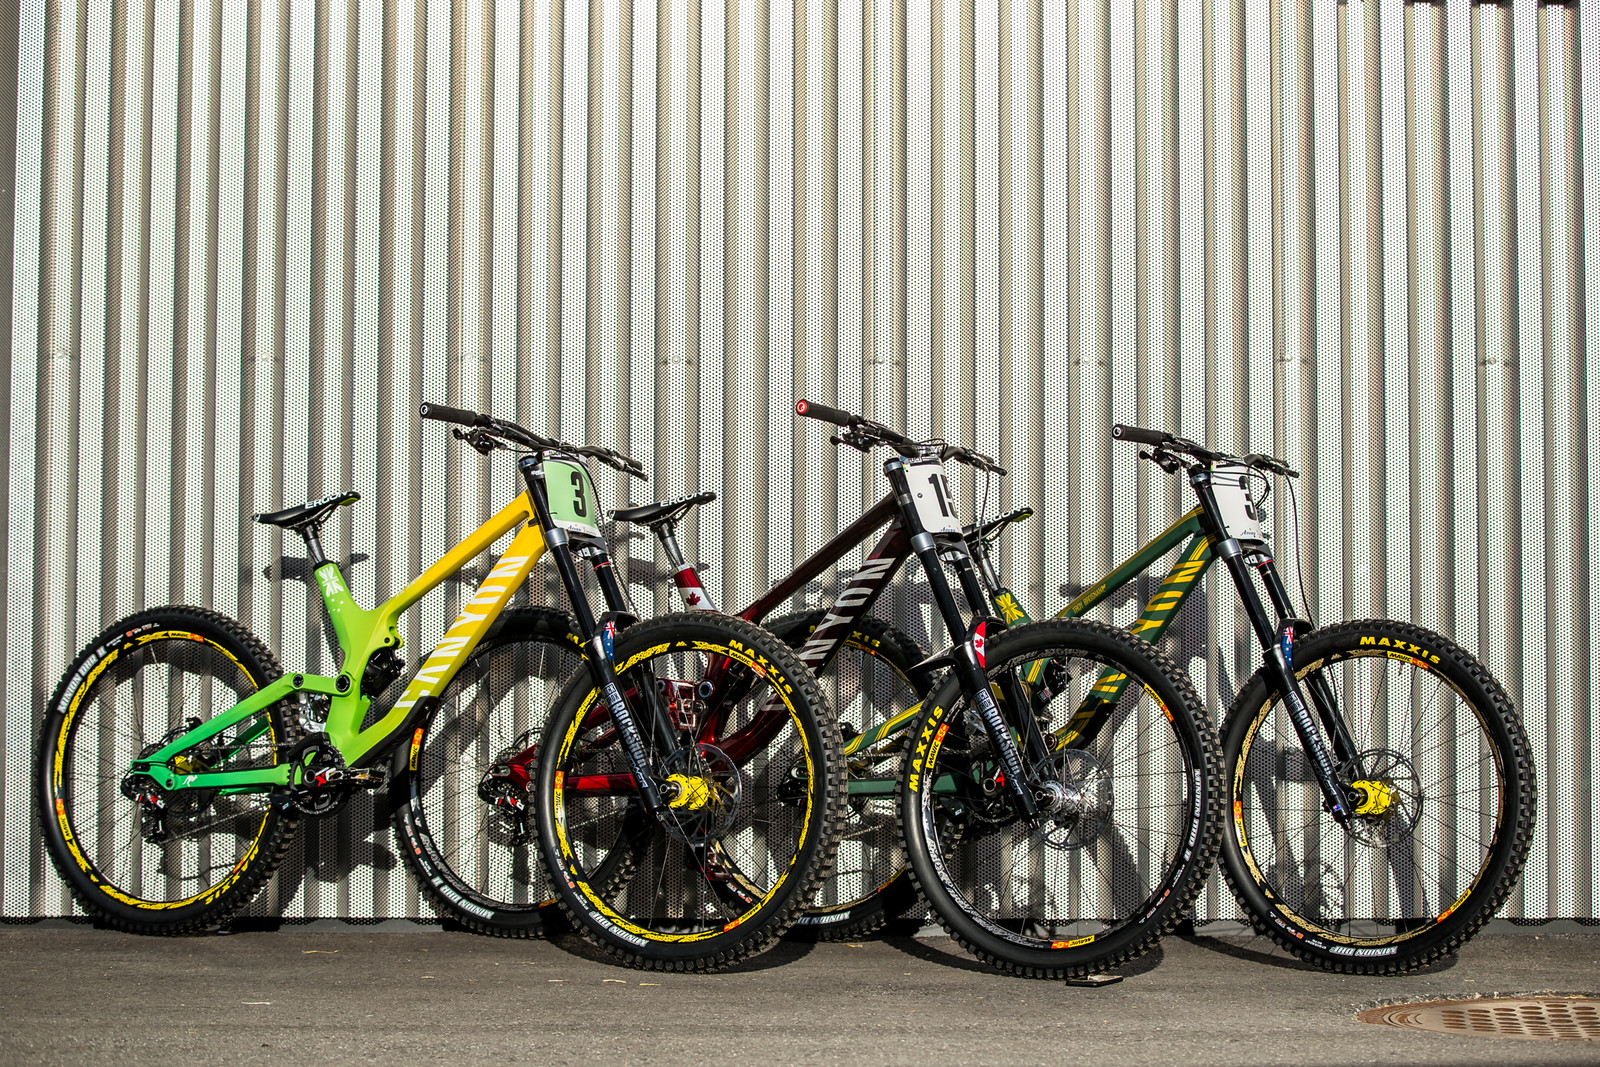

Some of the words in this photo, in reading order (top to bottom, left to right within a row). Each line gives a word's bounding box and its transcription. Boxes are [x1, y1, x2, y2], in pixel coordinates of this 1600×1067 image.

[570, 471, 587, 518] 3
[394, 556, 530, 708] CANYON
[1360, 636, 1440, 664] MAXXIS
[729, 639, 793, 695] MAXXIS
[1389, 652, 1412, 663] MAVIC
[57, 673, 84, 714] MINION
[909, 705, 944, 793] MAXXIS
[927, 741, 939, 767] MAVIC
[1193, 768, 1202, 817] MINION
[608, 922, 650, 947] MINION
[1354, 945, 1398, 957] MINION
